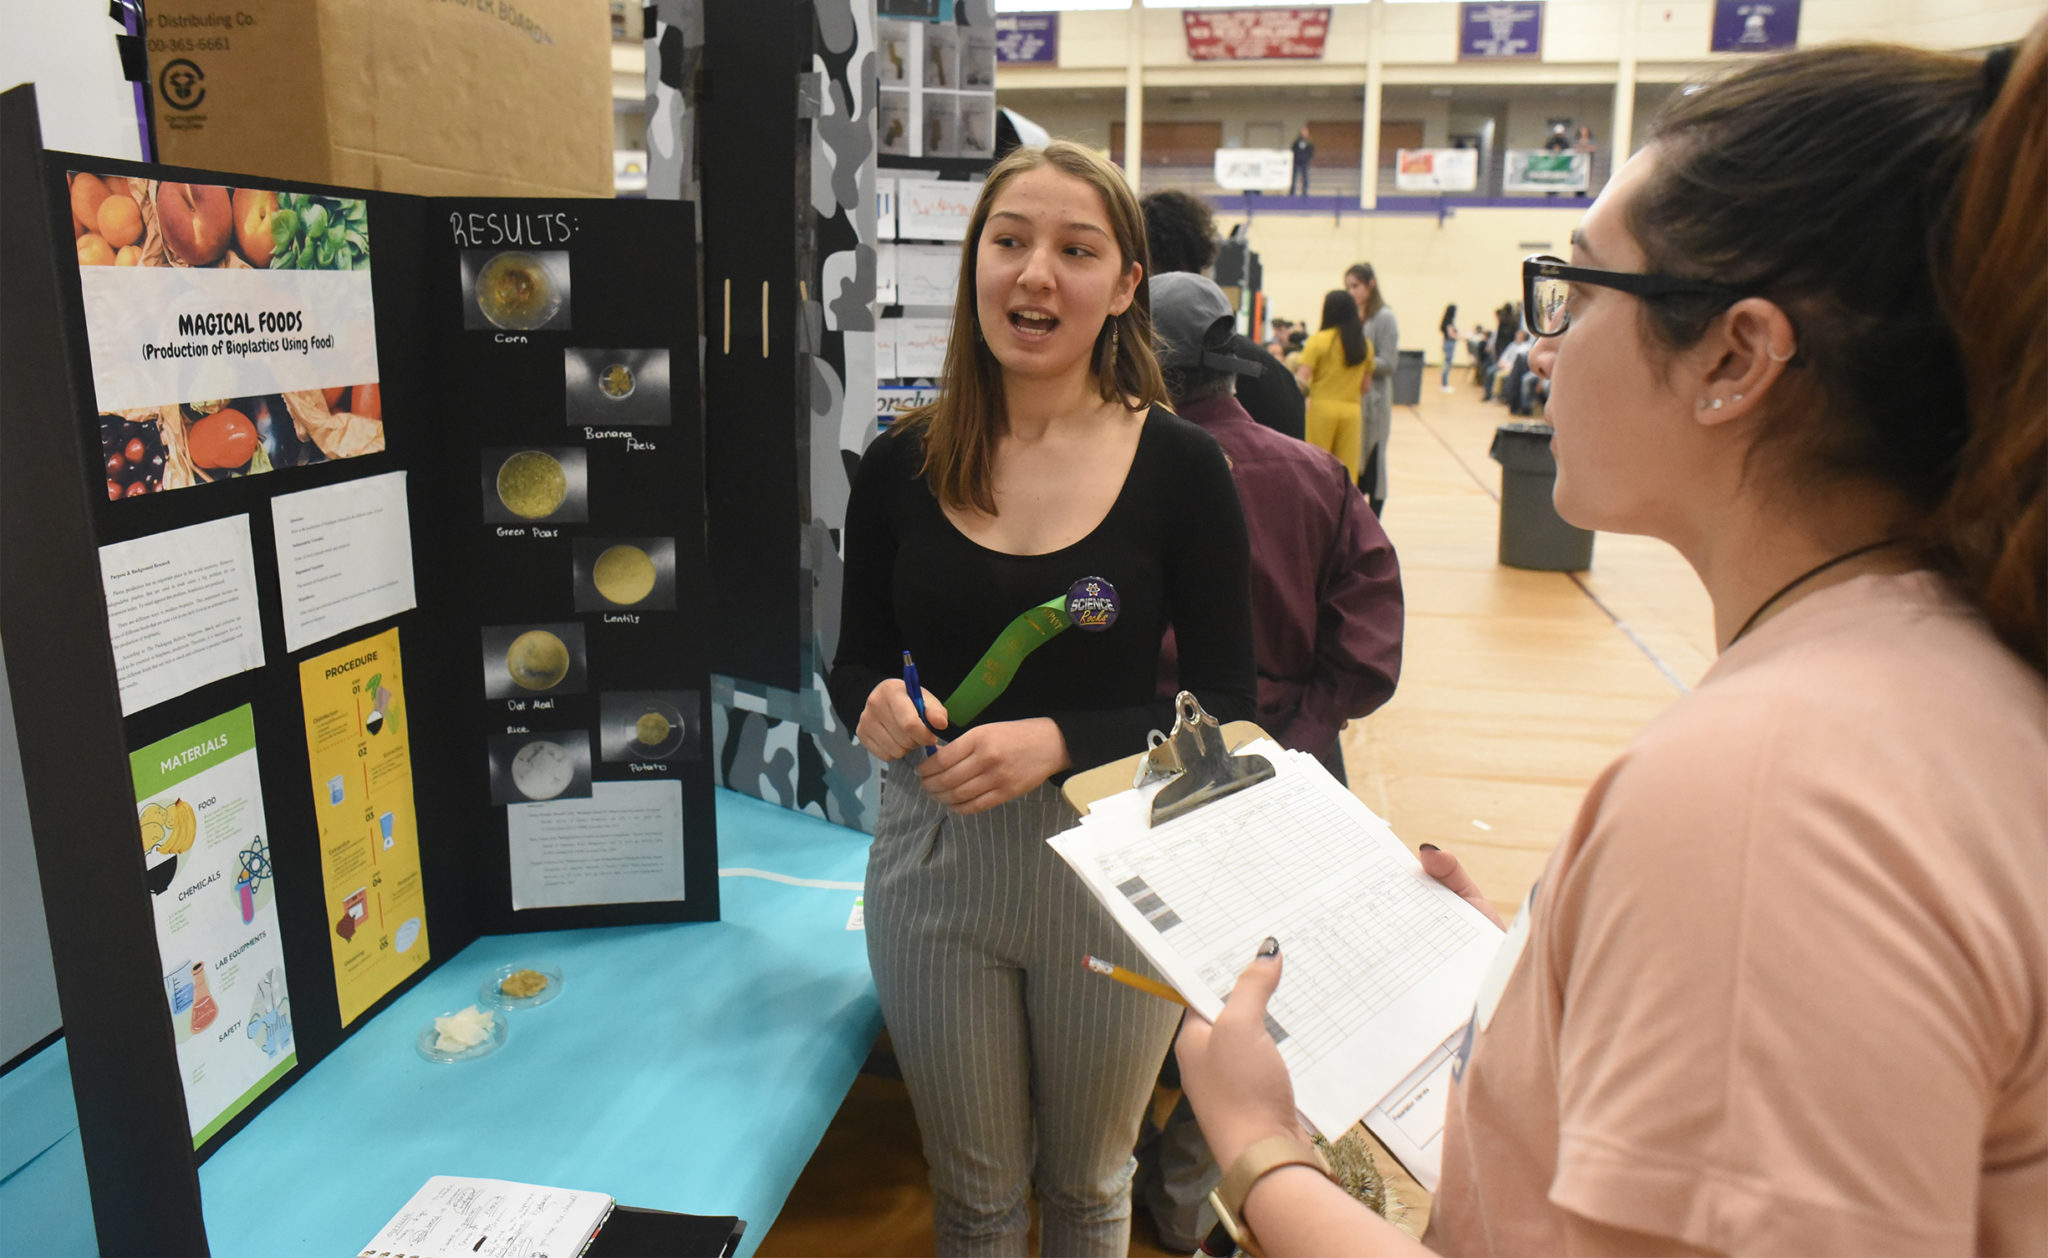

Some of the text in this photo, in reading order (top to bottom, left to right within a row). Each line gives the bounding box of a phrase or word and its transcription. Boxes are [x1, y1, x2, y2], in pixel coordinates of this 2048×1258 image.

[158, 12, 232, 30] Distributing
[236, 11, 257, 26] Co.
[148, 37, 231, 52] 00-365-6661
[450, 211, 580, 247] RESULTS:
[178, 310, 303, 336] MAGICAL FOODS
[494, 333, 528, 344] Corn
[142, 334, 335, 361] (Production of Bioplastics Using Food)
[583, 426, 633, 440] Banana
[626, 437, 656, 452] Peels
[496, 526, 525, 537] Green
[1070, 597, 1115, 613] SCIENCE
[603, 613, 640, 624] Lentils
[325, 651, 379, 680] PROCEDURE
[352, 685, 361, 695] 01
[160, 733, 228, 774] MATERIALS
[629, 763, 667, 773] Potato
[198, 796, 217, 811] FOOD
[178, 870, 221, 901] CHEMICALS
[215, 930, 267, 970] LAB EQUIPMENTS
[219, 1019, 242, 1043] SAFETY
